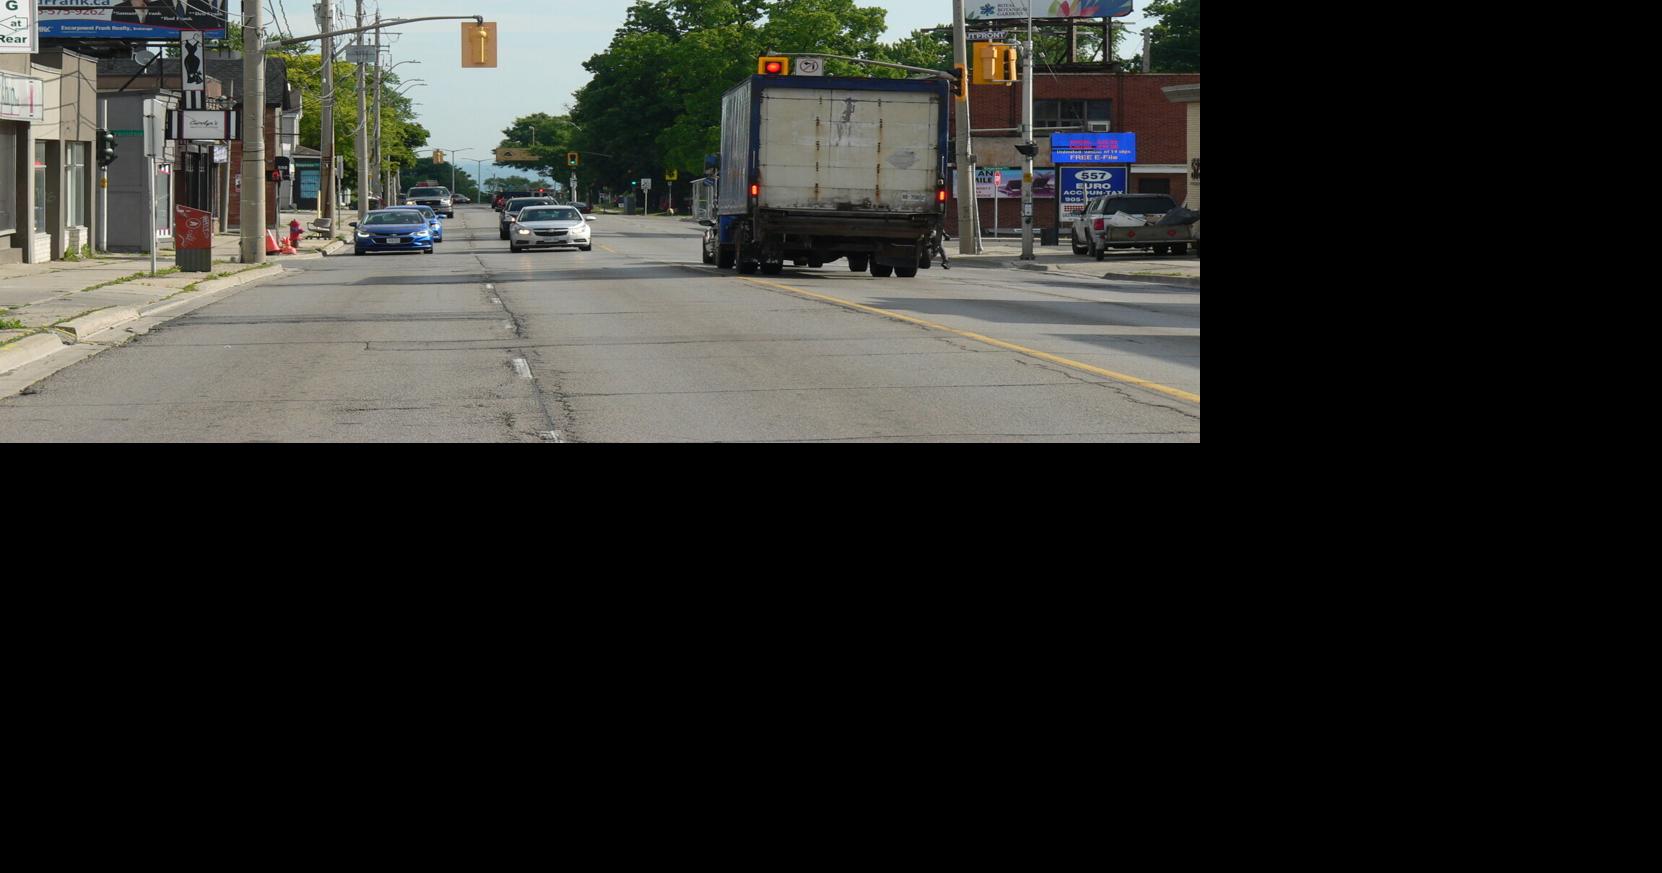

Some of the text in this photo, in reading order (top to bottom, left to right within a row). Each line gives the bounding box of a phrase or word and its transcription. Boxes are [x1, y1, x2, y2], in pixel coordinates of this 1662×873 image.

[6, 0, 18, 11] G
[0, 35, 28, 44] Rear
[1081, 172, 1106, 180] 557
